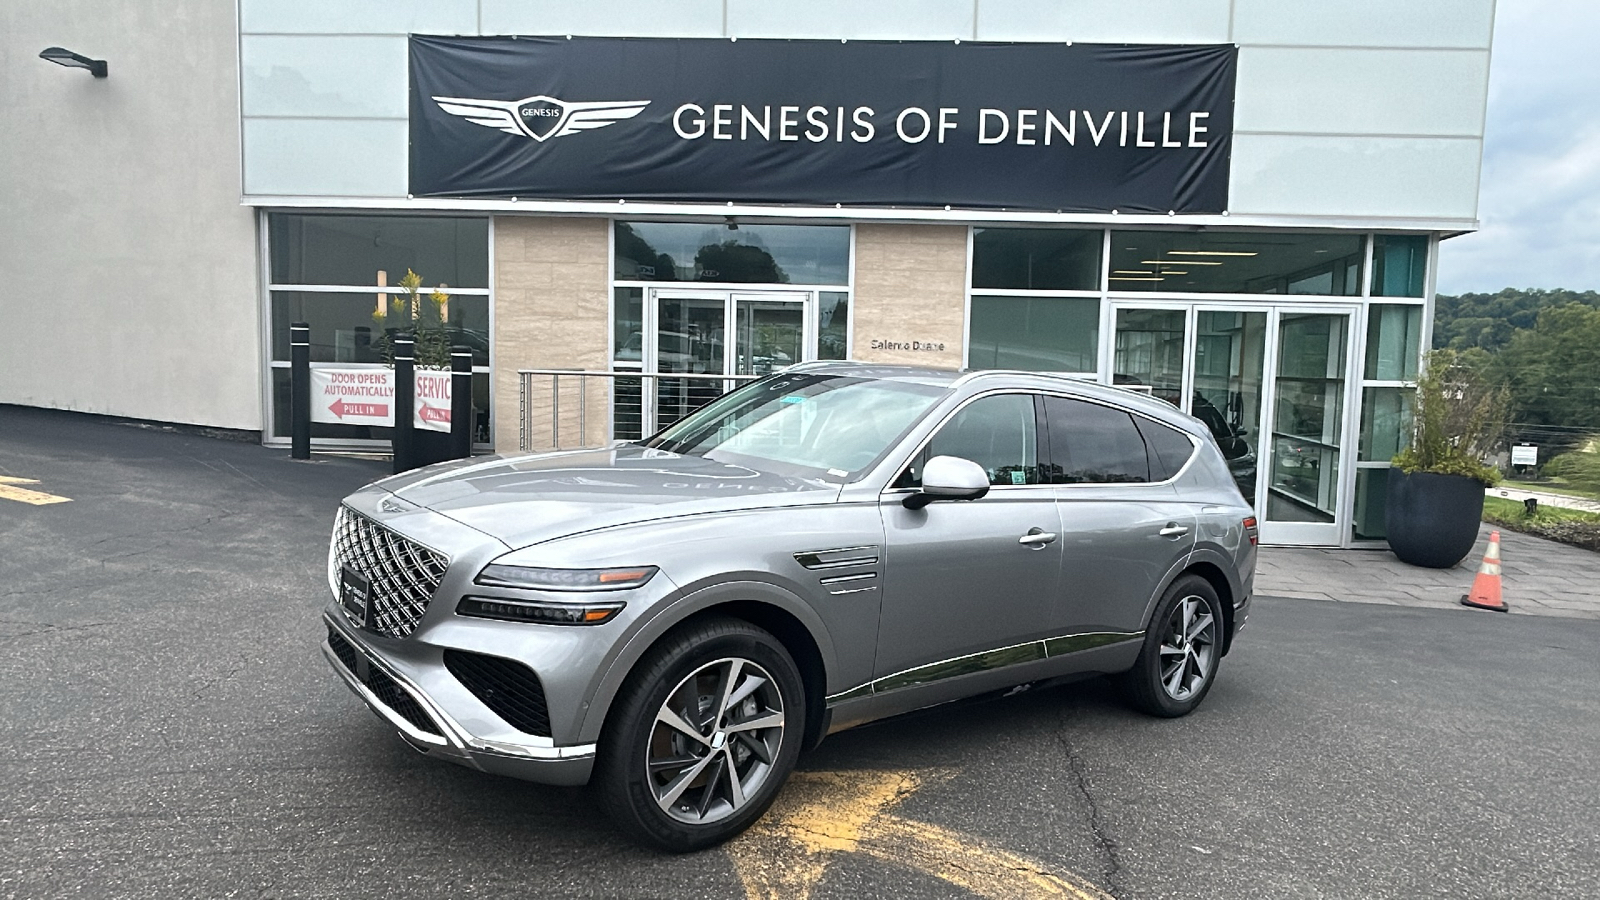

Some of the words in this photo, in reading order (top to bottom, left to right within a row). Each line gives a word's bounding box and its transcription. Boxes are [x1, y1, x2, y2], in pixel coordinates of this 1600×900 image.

[521, 107, 560, 118] GENESIS
[672, 103, 876, 143] GENESIS
[896, 106, 959, 144] OF
[978, 108, 1210, 148] DENVILLE
[331, 373, 356, 383] DOOR
[357, 374, 387, 385] OPENS
[324, 385, 395, 397] AUTOMATICALLY
[417, 376, 451, 399] SERVIC
[344, 404, 363, 414] PULL
[366, 405, 375, 414] IN
